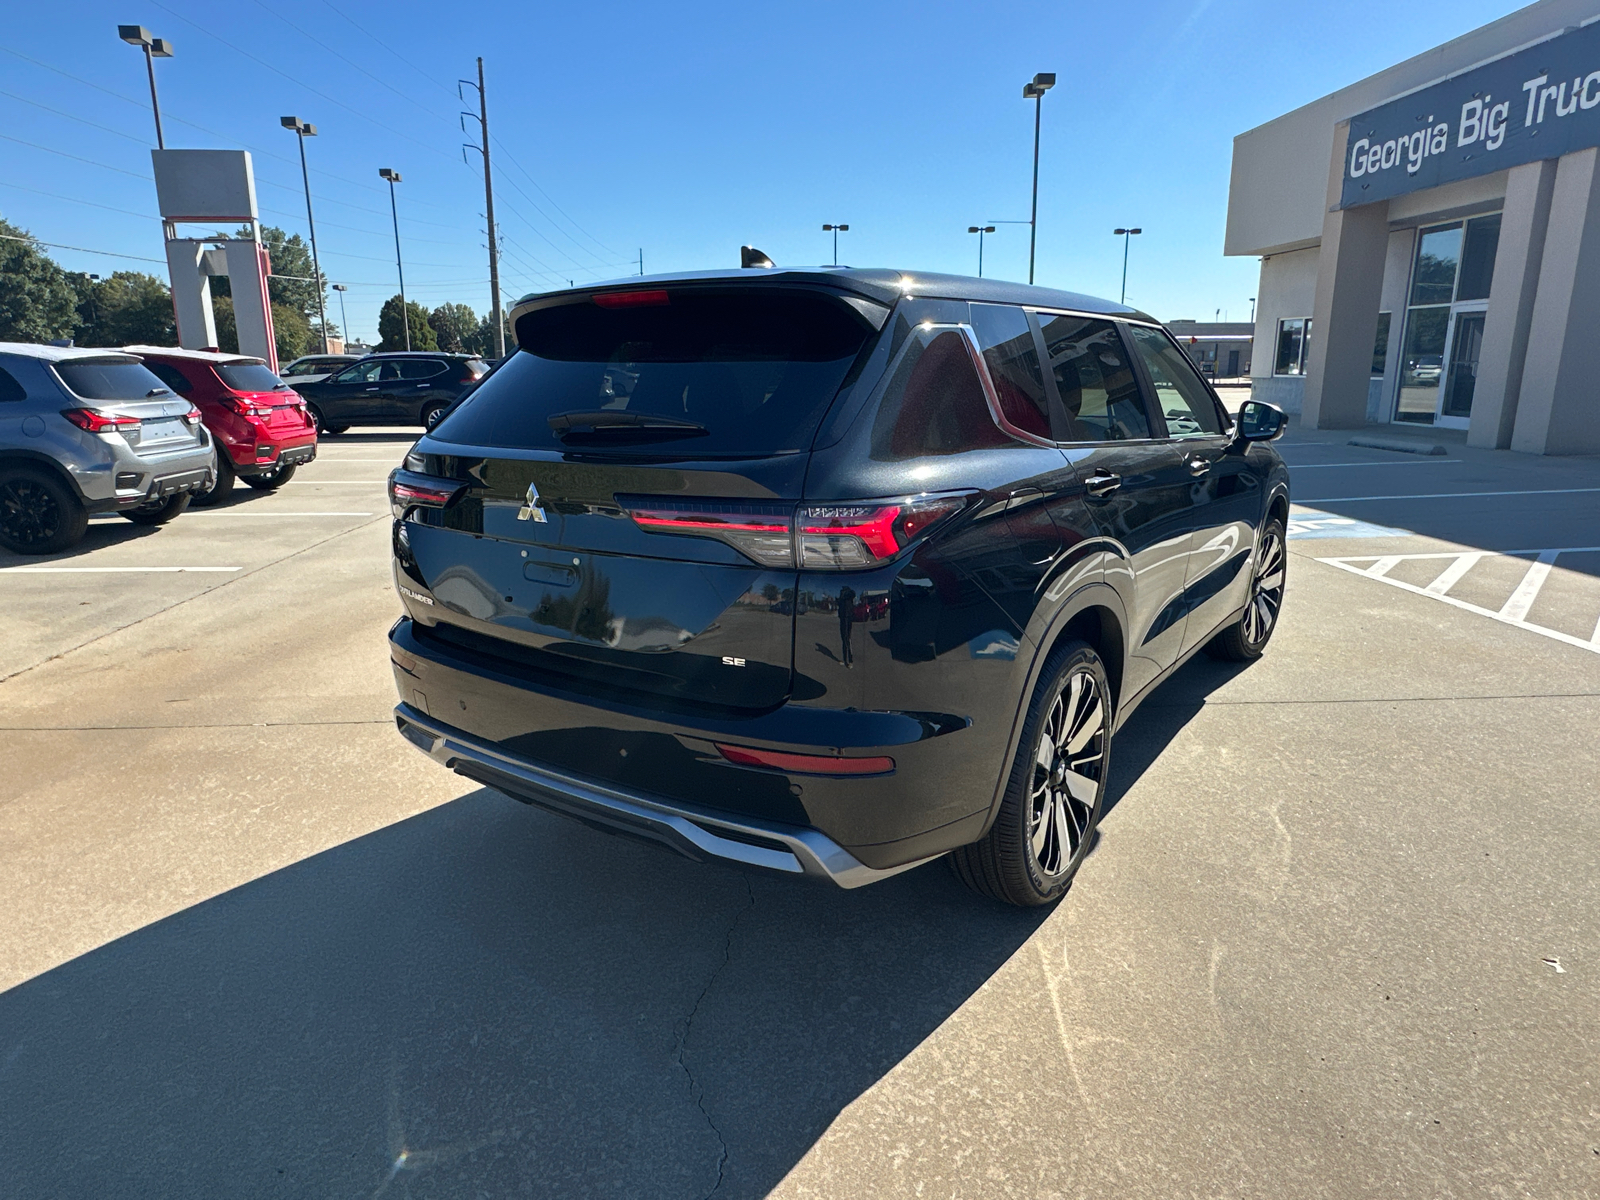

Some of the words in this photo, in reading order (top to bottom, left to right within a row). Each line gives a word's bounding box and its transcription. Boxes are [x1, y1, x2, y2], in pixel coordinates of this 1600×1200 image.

[1350, 115, 1448, 178] Georgia
[1457, 94, 1510, 151] Big
[722, 656, 746, 667] SE
